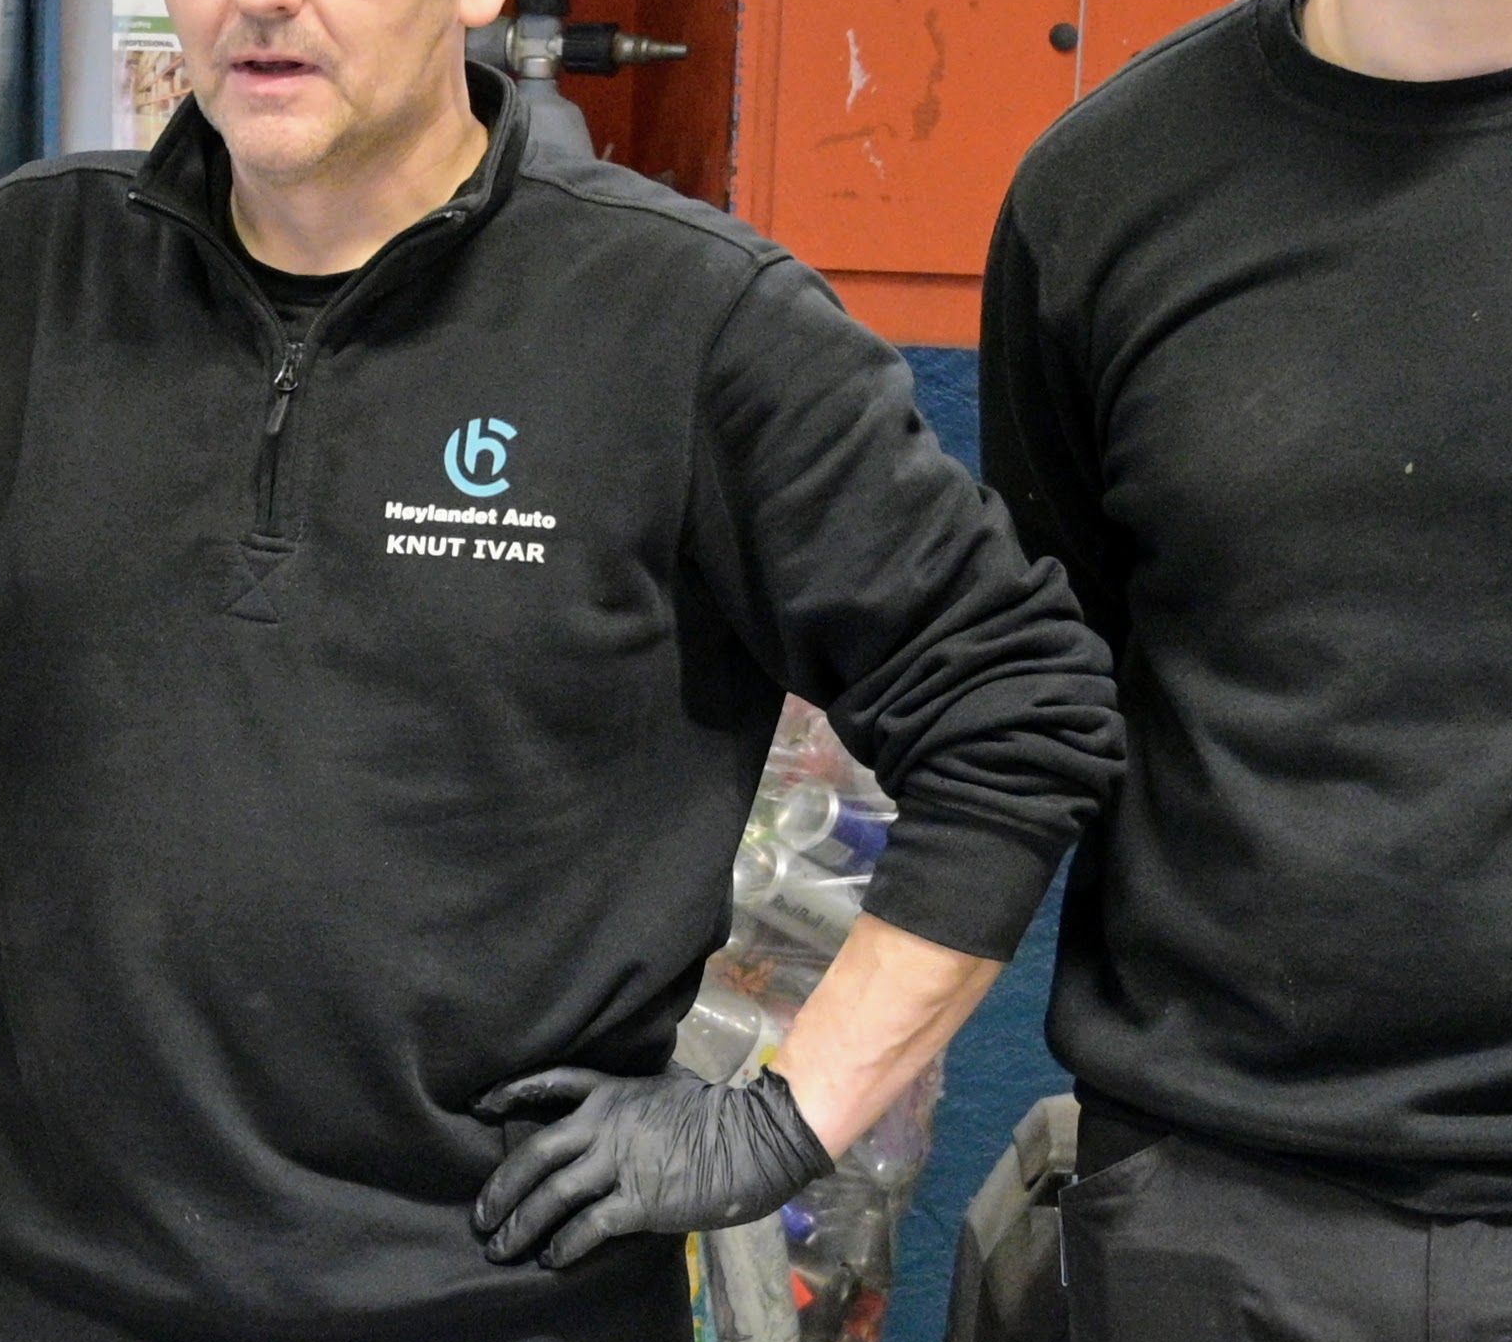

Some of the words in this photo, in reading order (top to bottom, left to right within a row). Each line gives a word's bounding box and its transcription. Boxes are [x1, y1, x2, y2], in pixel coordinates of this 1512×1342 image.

[385, 501, 498, 525] Høylandet
[502, 509, 557, 529] Auto
[386, 535, 466, 556] KNUT
[473, 540, 545, 563] IVAR
